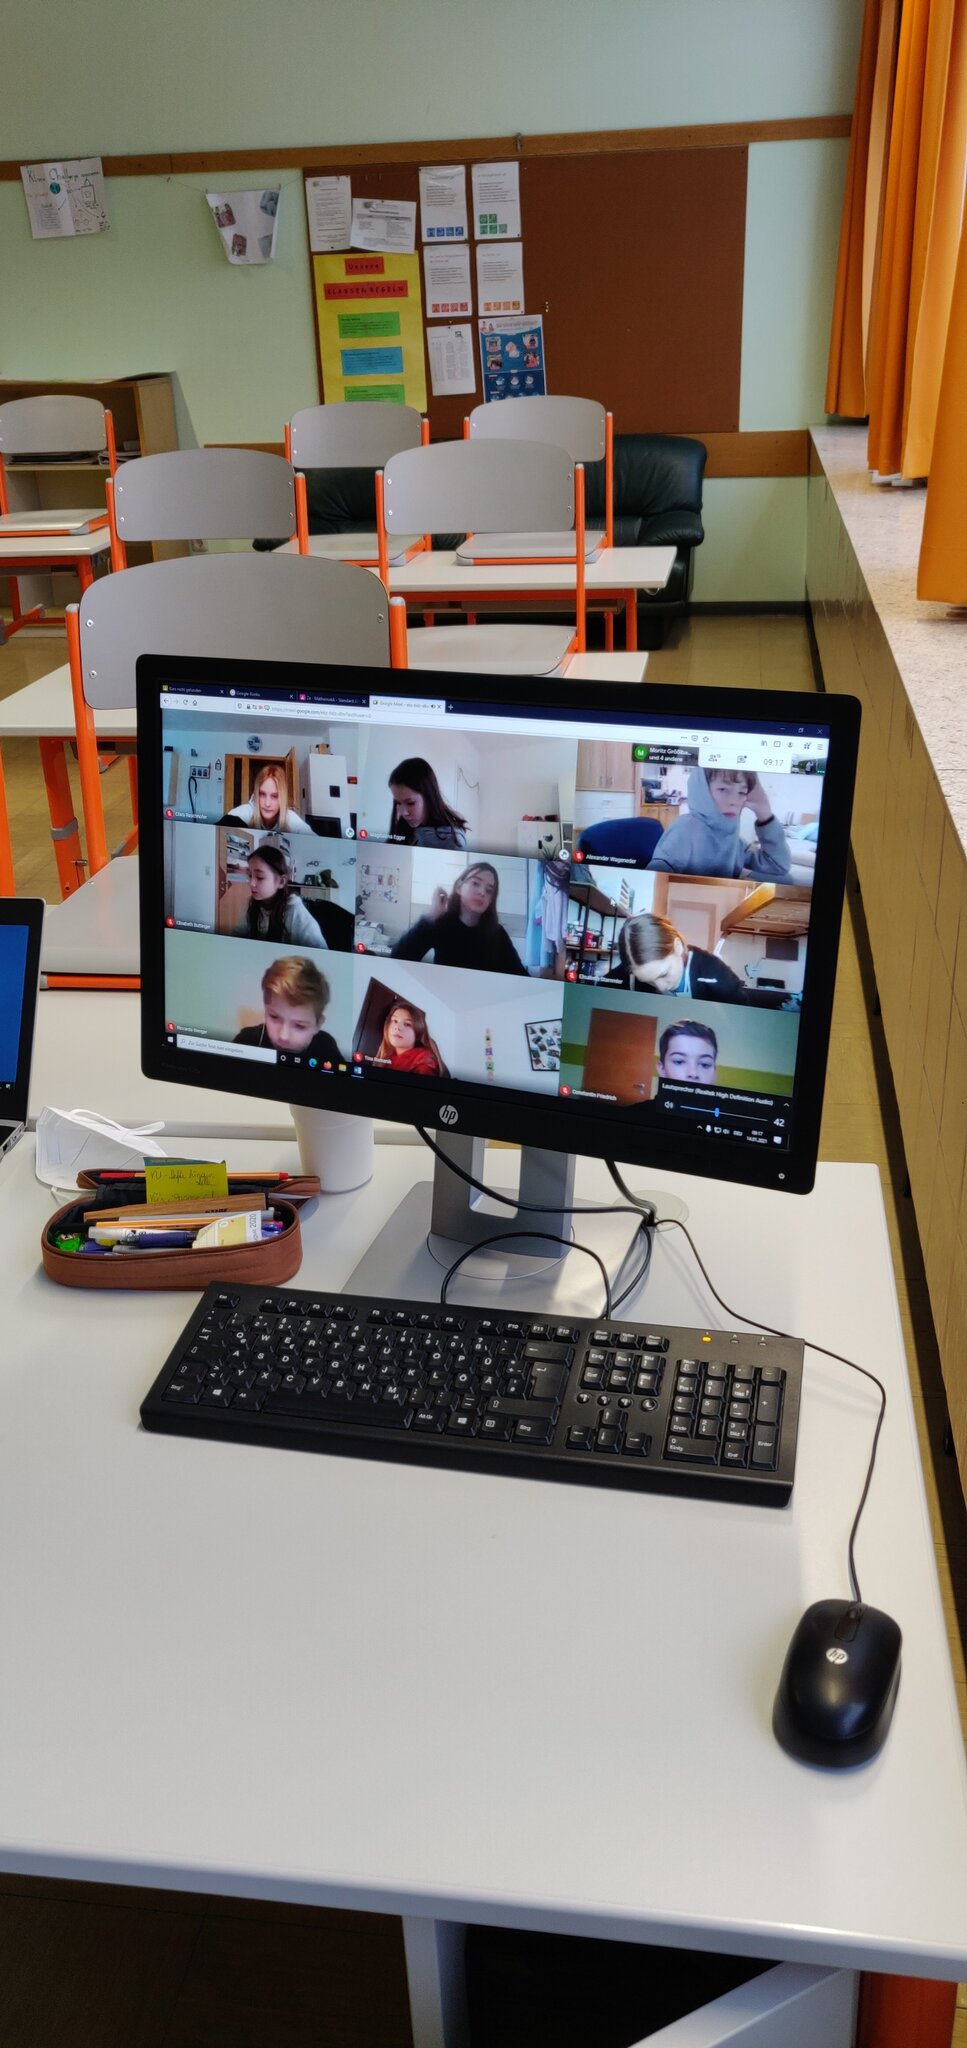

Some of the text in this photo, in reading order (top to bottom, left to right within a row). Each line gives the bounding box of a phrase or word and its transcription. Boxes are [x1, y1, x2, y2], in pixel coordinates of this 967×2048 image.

[763, 758, 784, 767] 09:17
[572, 1088, 617, 1101] Constantin Friedrich
[662, 1083, 774, 1107] Lautsprecher (Realtek High Definition Audio)
[440, 1105, 458, 1124] hp
[773, 1118, 785, 1127] 42
[249, 1213, 257, 1228] 2020
[332, 1361, 339, 1369] G
[827, 1648, 847, 1664] hp
